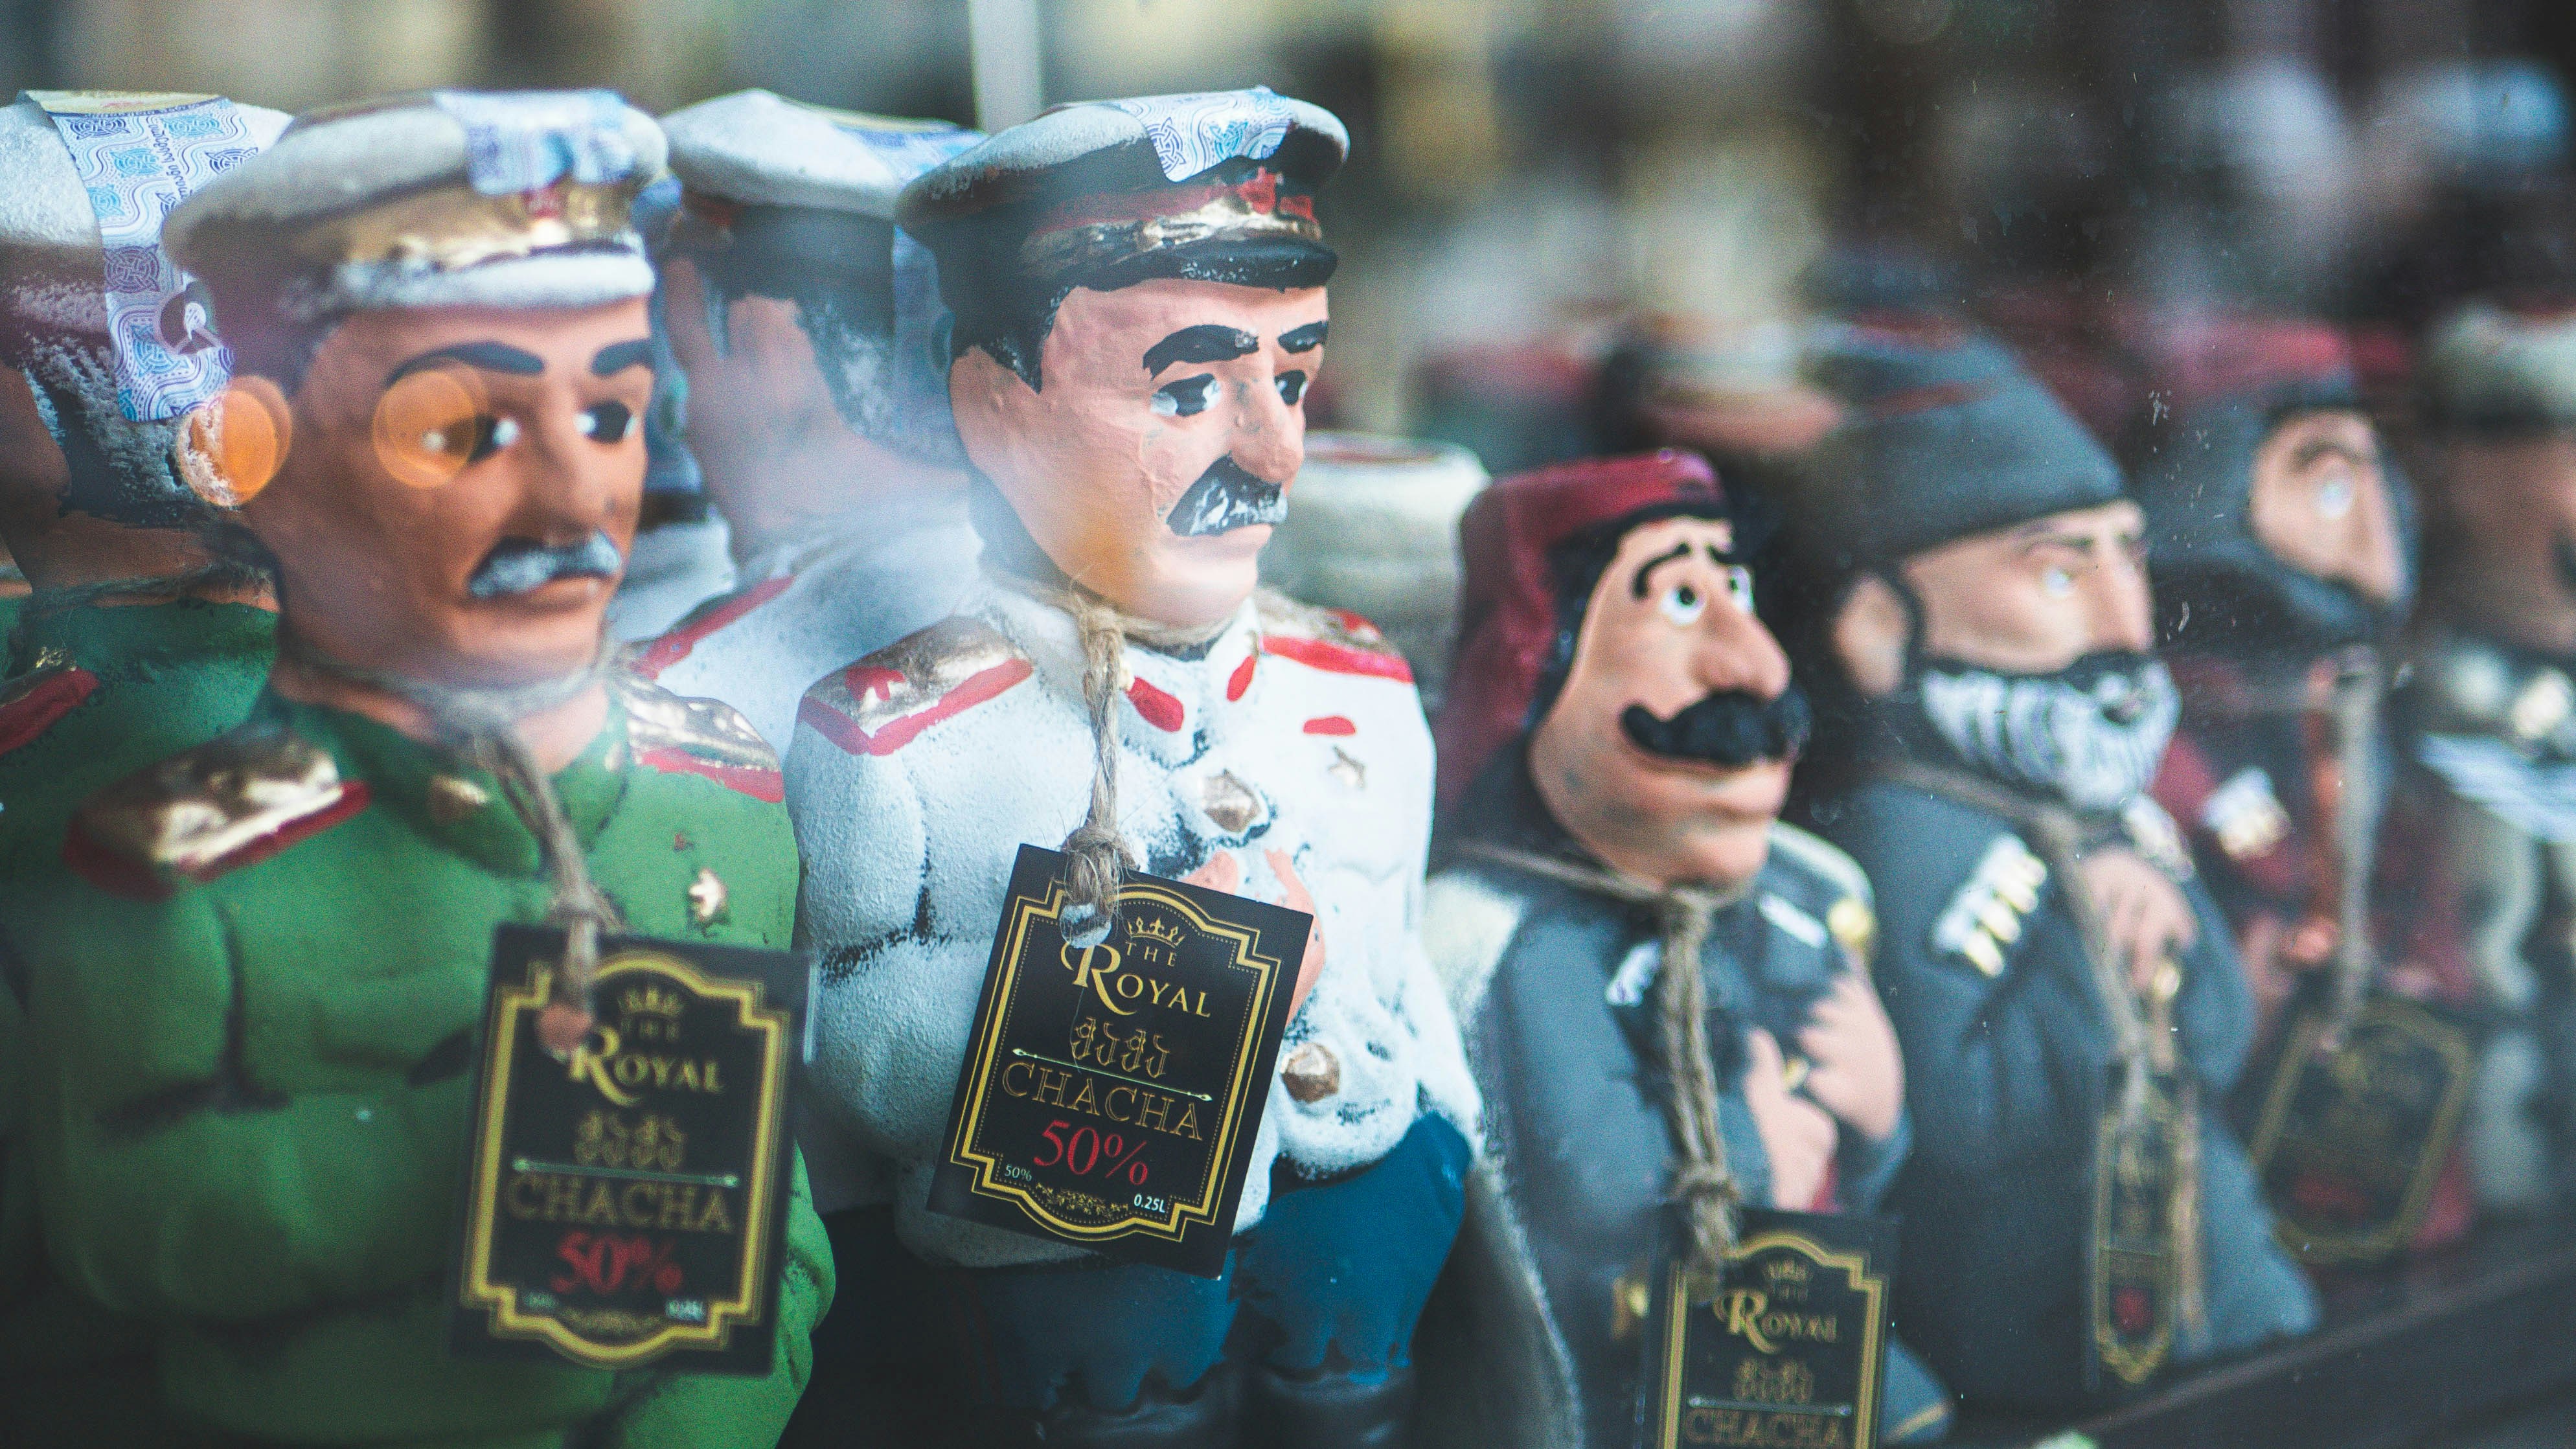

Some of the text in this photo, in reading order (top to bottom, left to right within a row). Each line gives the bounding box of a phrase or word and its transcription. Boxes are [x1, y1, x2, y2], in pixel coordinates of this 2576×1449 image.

[1125, 941, 1178, 967] THE
[1002, 1062, 1203, 1141] CHACHA
[1004, 1163, 1033, 1182] 50%
[1033, 1120, 1148, 1185] 50%
[507, 1174, 735, 1232] CHACHA
[1134, 1193, 1166, 1214] 0.25L
[551, 1232, 684, 1295] 50%
